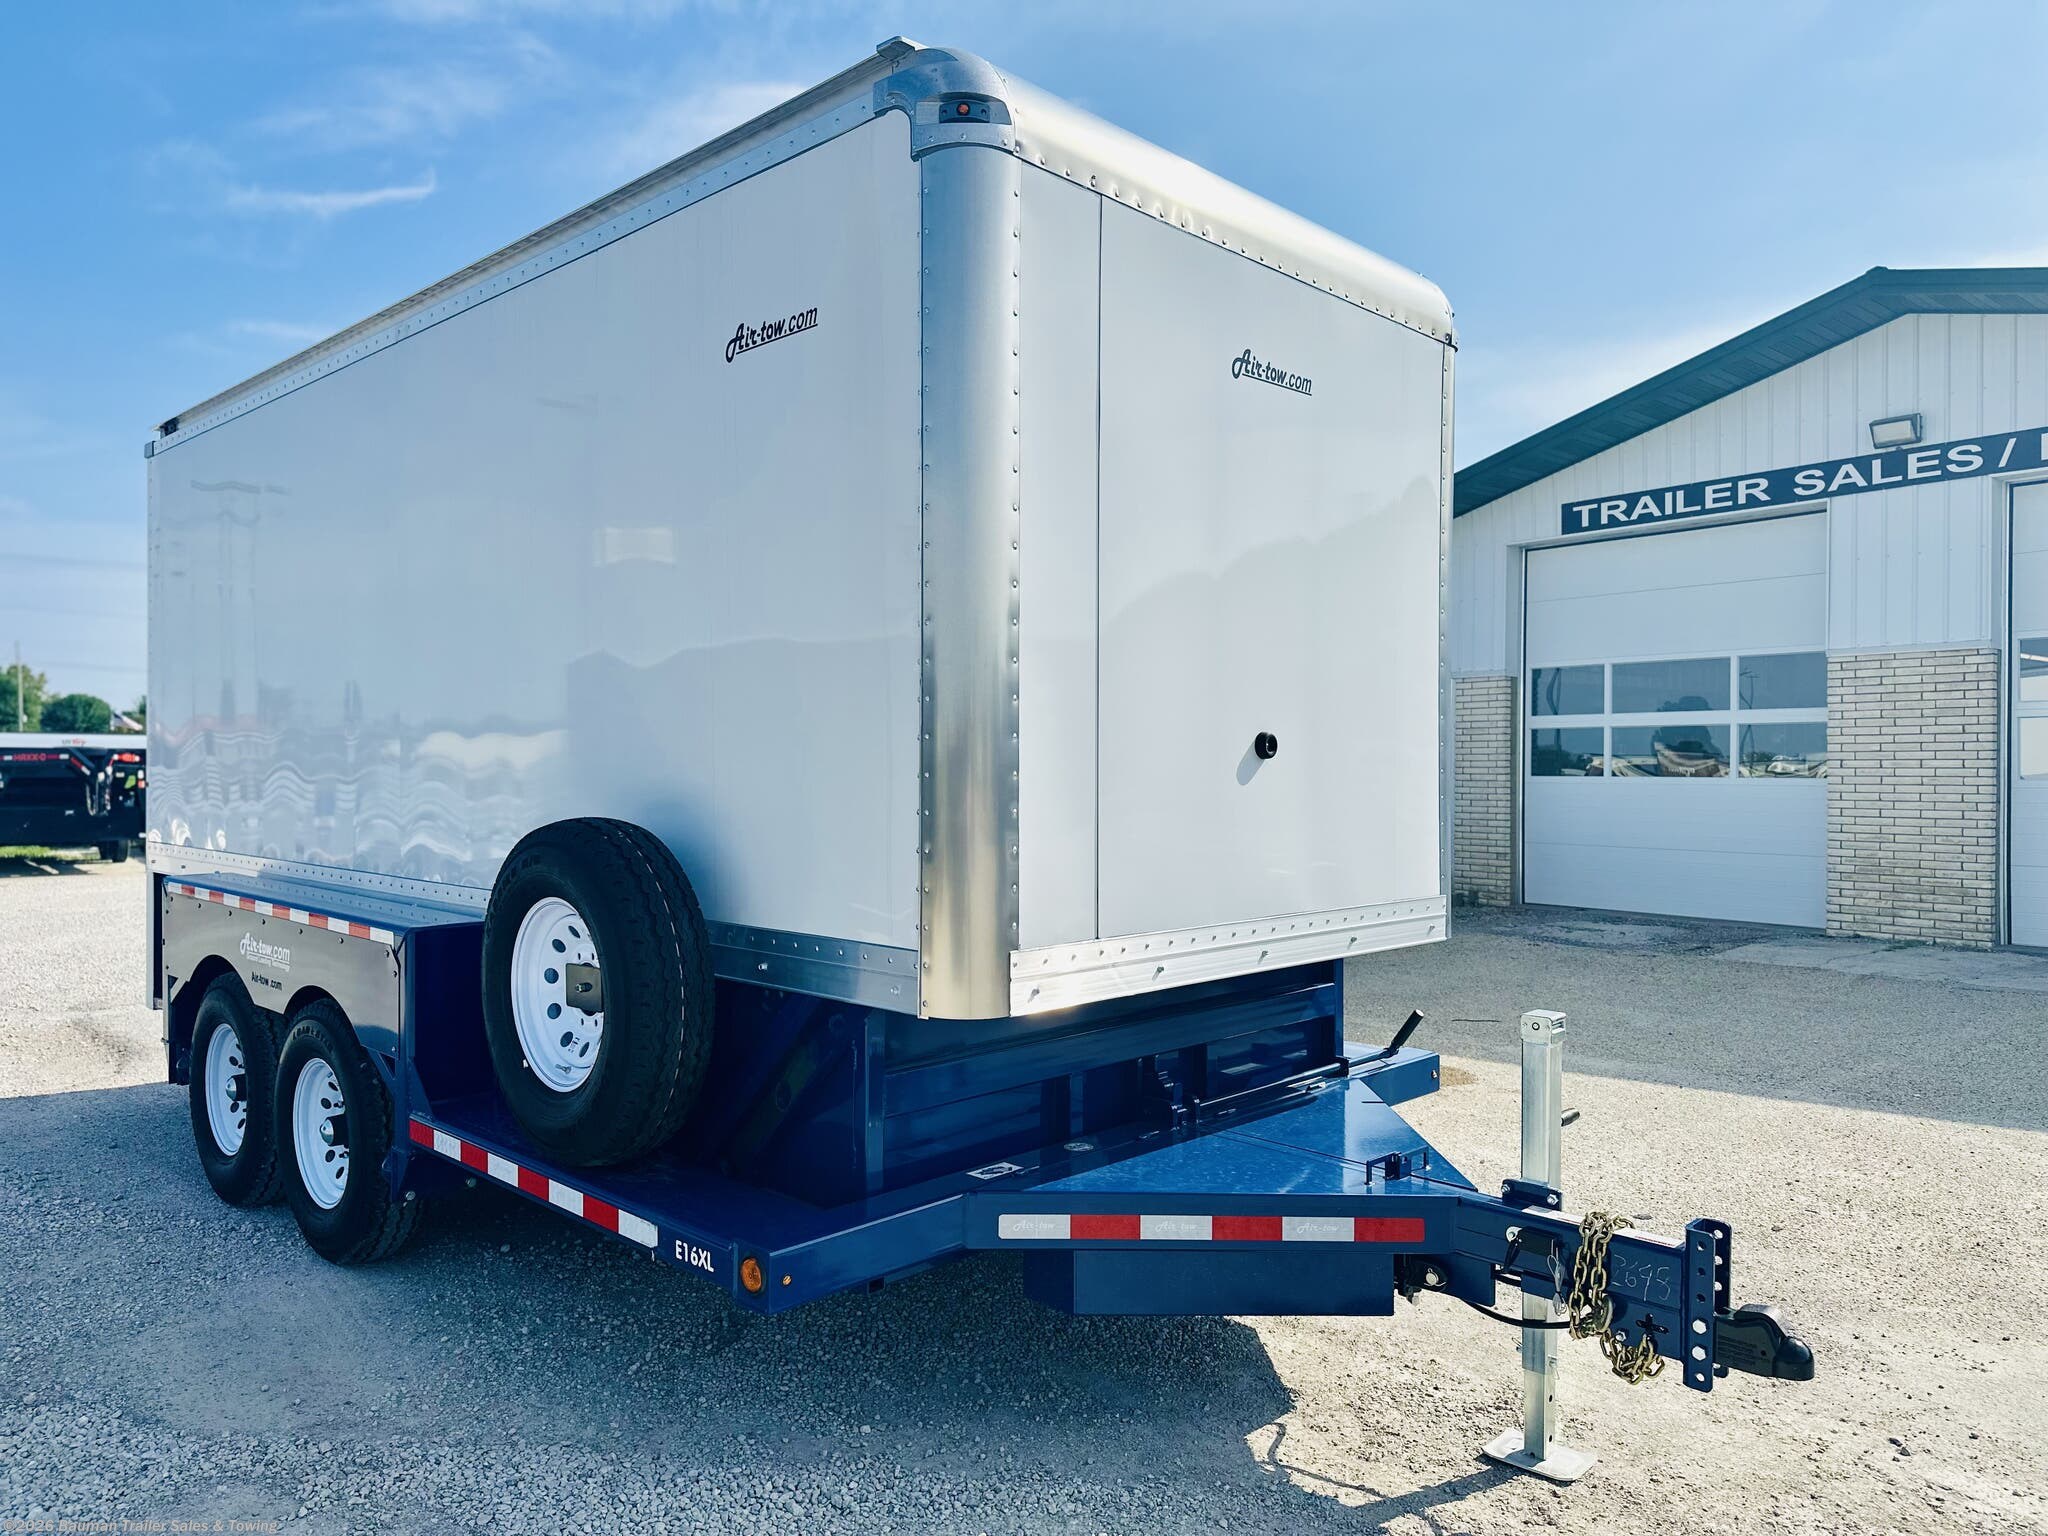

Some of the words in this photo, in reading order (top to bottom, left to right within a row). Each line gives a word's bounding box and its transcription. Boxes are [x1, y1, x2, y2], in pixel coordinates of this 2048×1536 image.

[726, 307, 818, 363] Air-tow.com
[1231, 349, 1312, 395] Air-tow.com
[1573, 477, 1771, 528] TRAILER
[1793, 444, 1984, 496] SALES
[1998, 438, 2017, 468] /
[240, 932, 290, 962] Air-tow.com
[1013, 1218, 1055, 1232] Air-tow
[1155, 1220, 1198, 1233] Air-tow
[1296, 1222, 1340, 1234] Air-tow
[675, 1240, 715, 1273] E16XL
